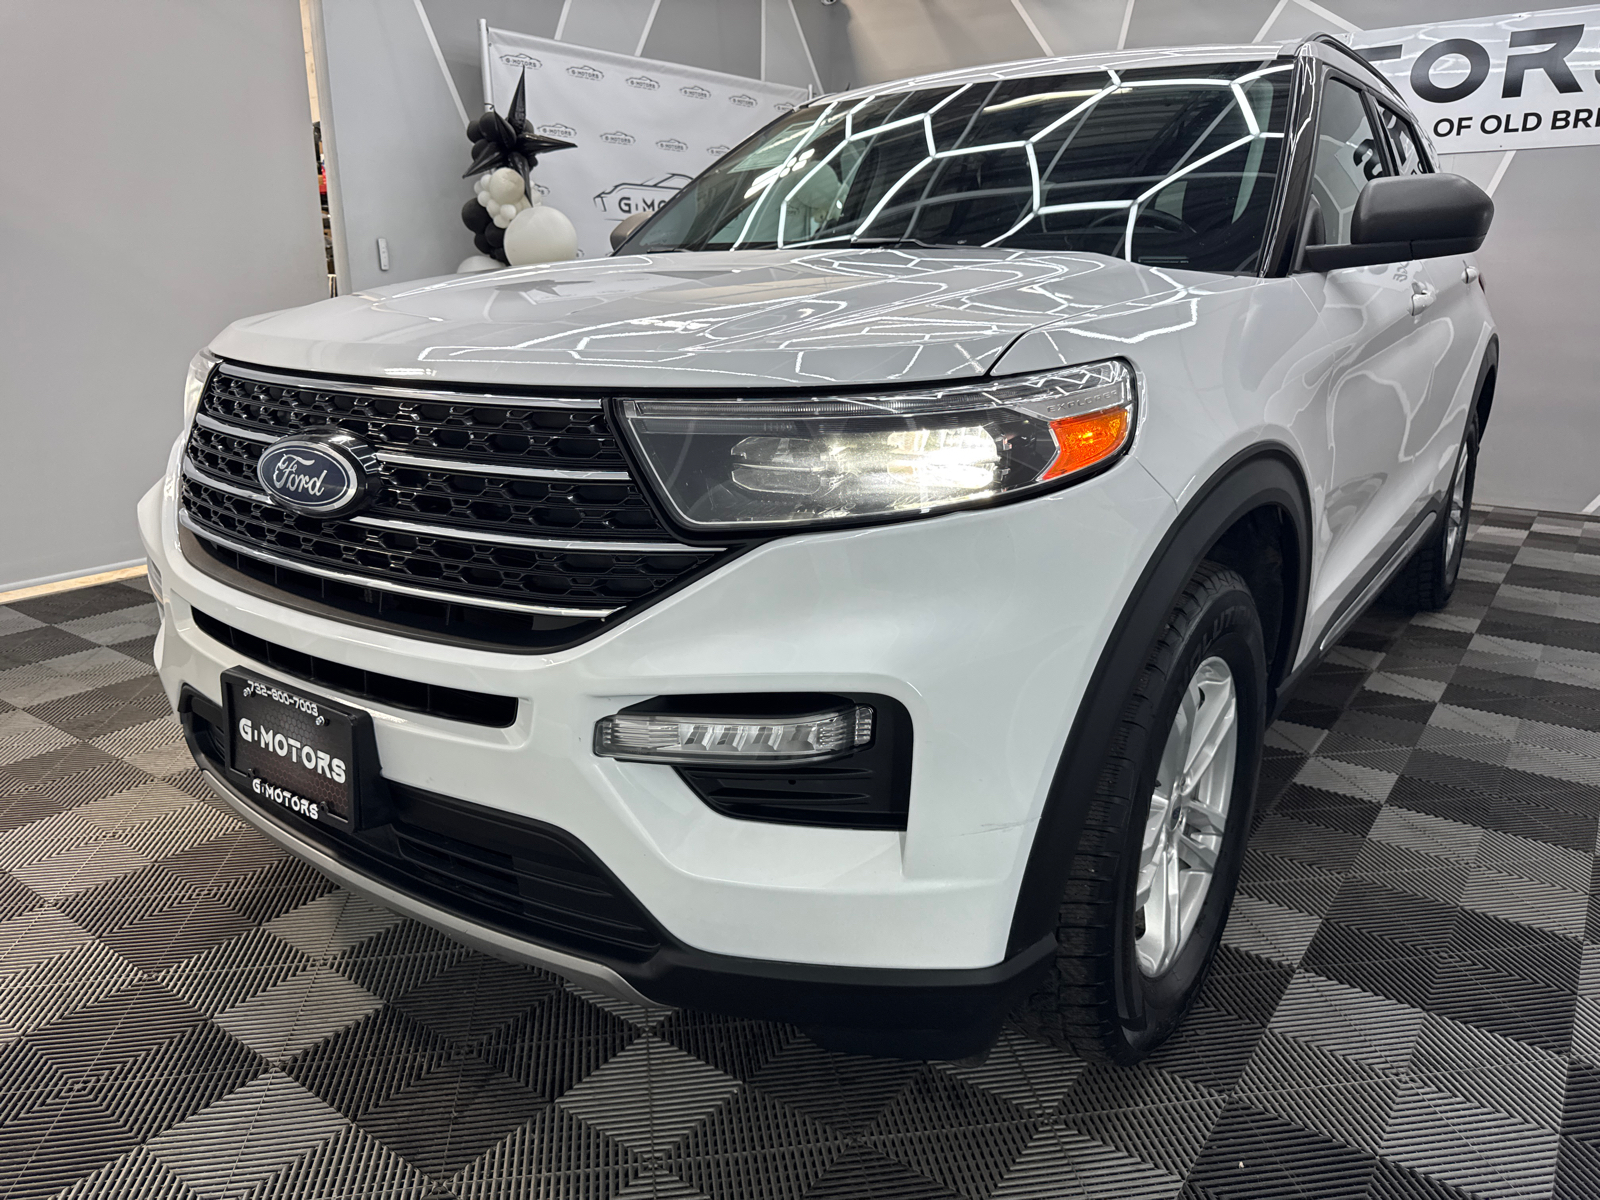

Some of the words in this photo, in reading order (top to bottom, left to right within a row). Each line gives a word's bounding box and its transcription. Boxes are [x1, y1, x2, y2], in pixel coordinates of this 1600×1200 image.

[1433, 116, 1473, 138] OF
[1480, 111, 1542, 135] OLD
[1047, 389, 1118, 413] EXPLORER
[273, 453, 328, 496] Ford
[247, 680, 319, 717] 732-800-7003
